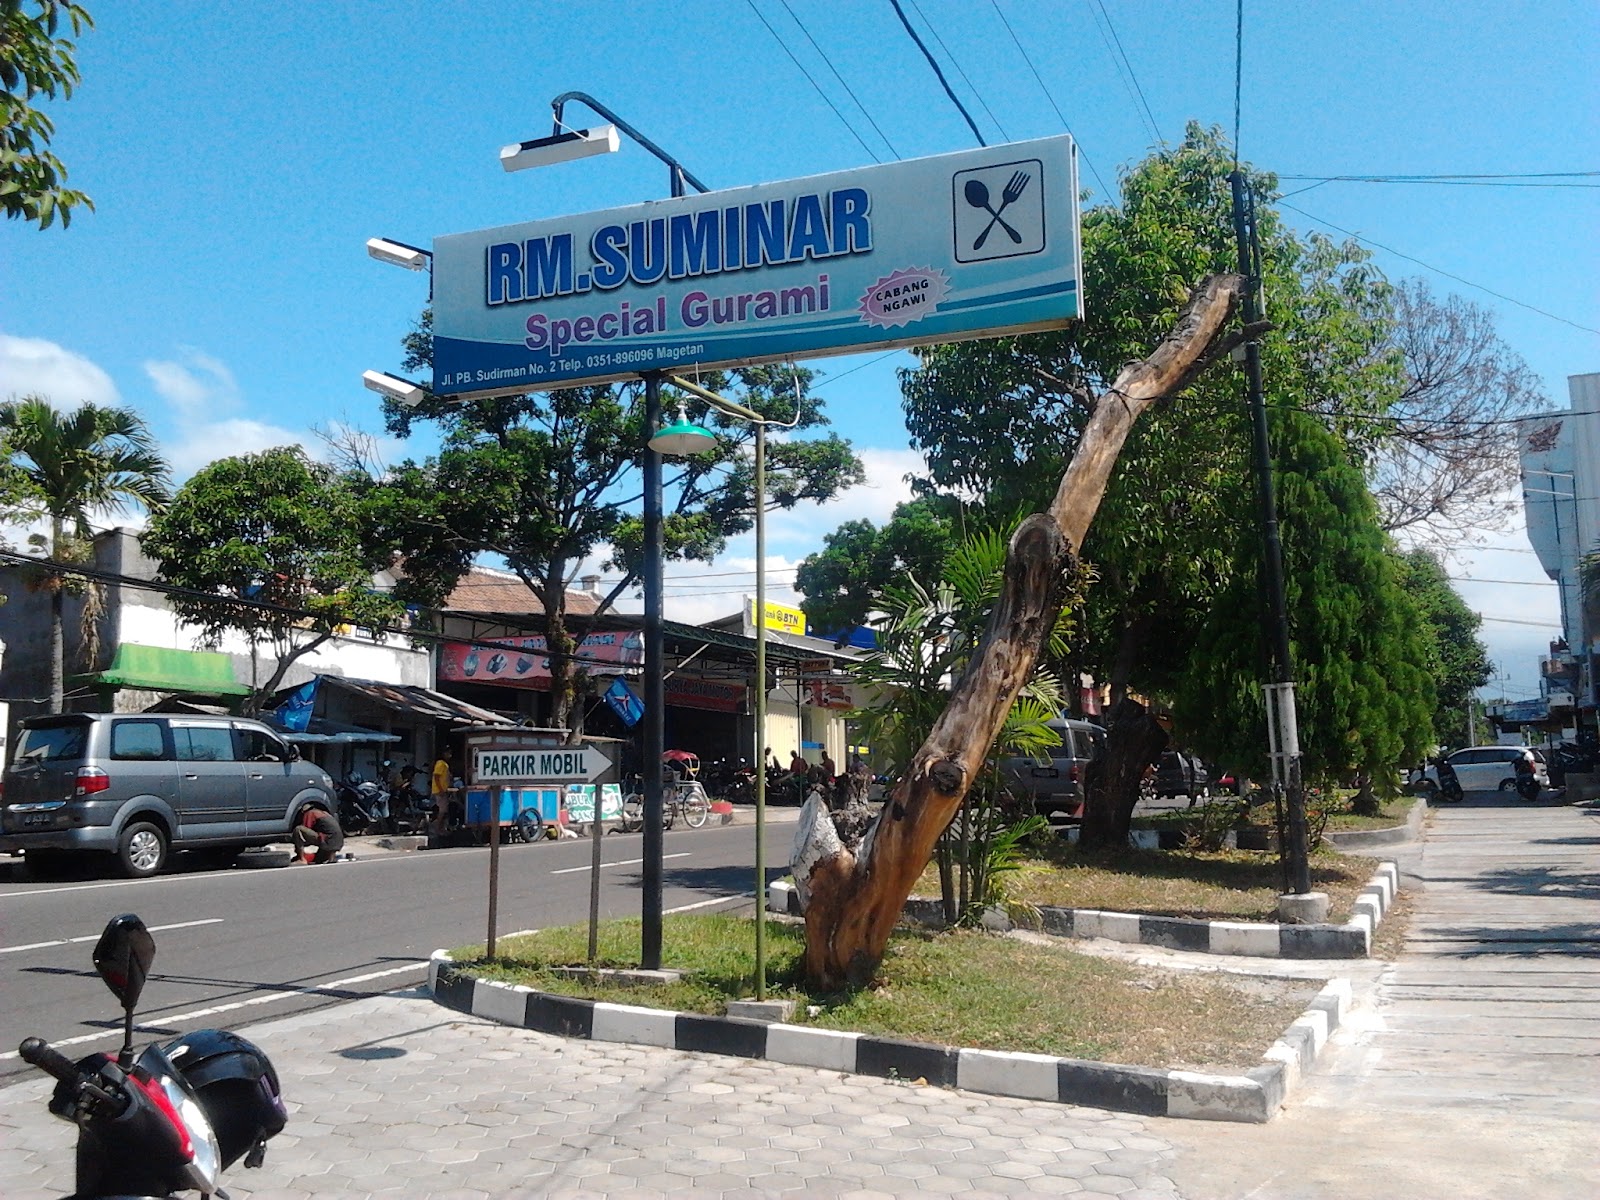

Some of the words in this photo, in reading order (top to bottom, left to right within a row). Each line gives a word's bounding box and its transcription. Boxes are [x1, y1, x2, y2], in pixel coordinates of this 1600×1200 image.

[876, 279, 929, 302] CABANG
[883, 293, 926, 313] NGAWI
[525, 296, 667, 356] Special
[680, 274, 830, 328] Gurami
[456, 373, 475, 384] PB.
[476, 364, 527, 382] Sudirman
[528, 363, 547, 375] No.
[549, 360, 557, 373] 2
[559, 359, 585, 373] Telp.
[586, 348, 655, 368] 0351-896096
[656, 343, 705, 361] Magetan
[783, 613, 799, 625] BTN
[482, 755, 536, 776] PARKIR
[540, 753, 588, 775] MOBIL
